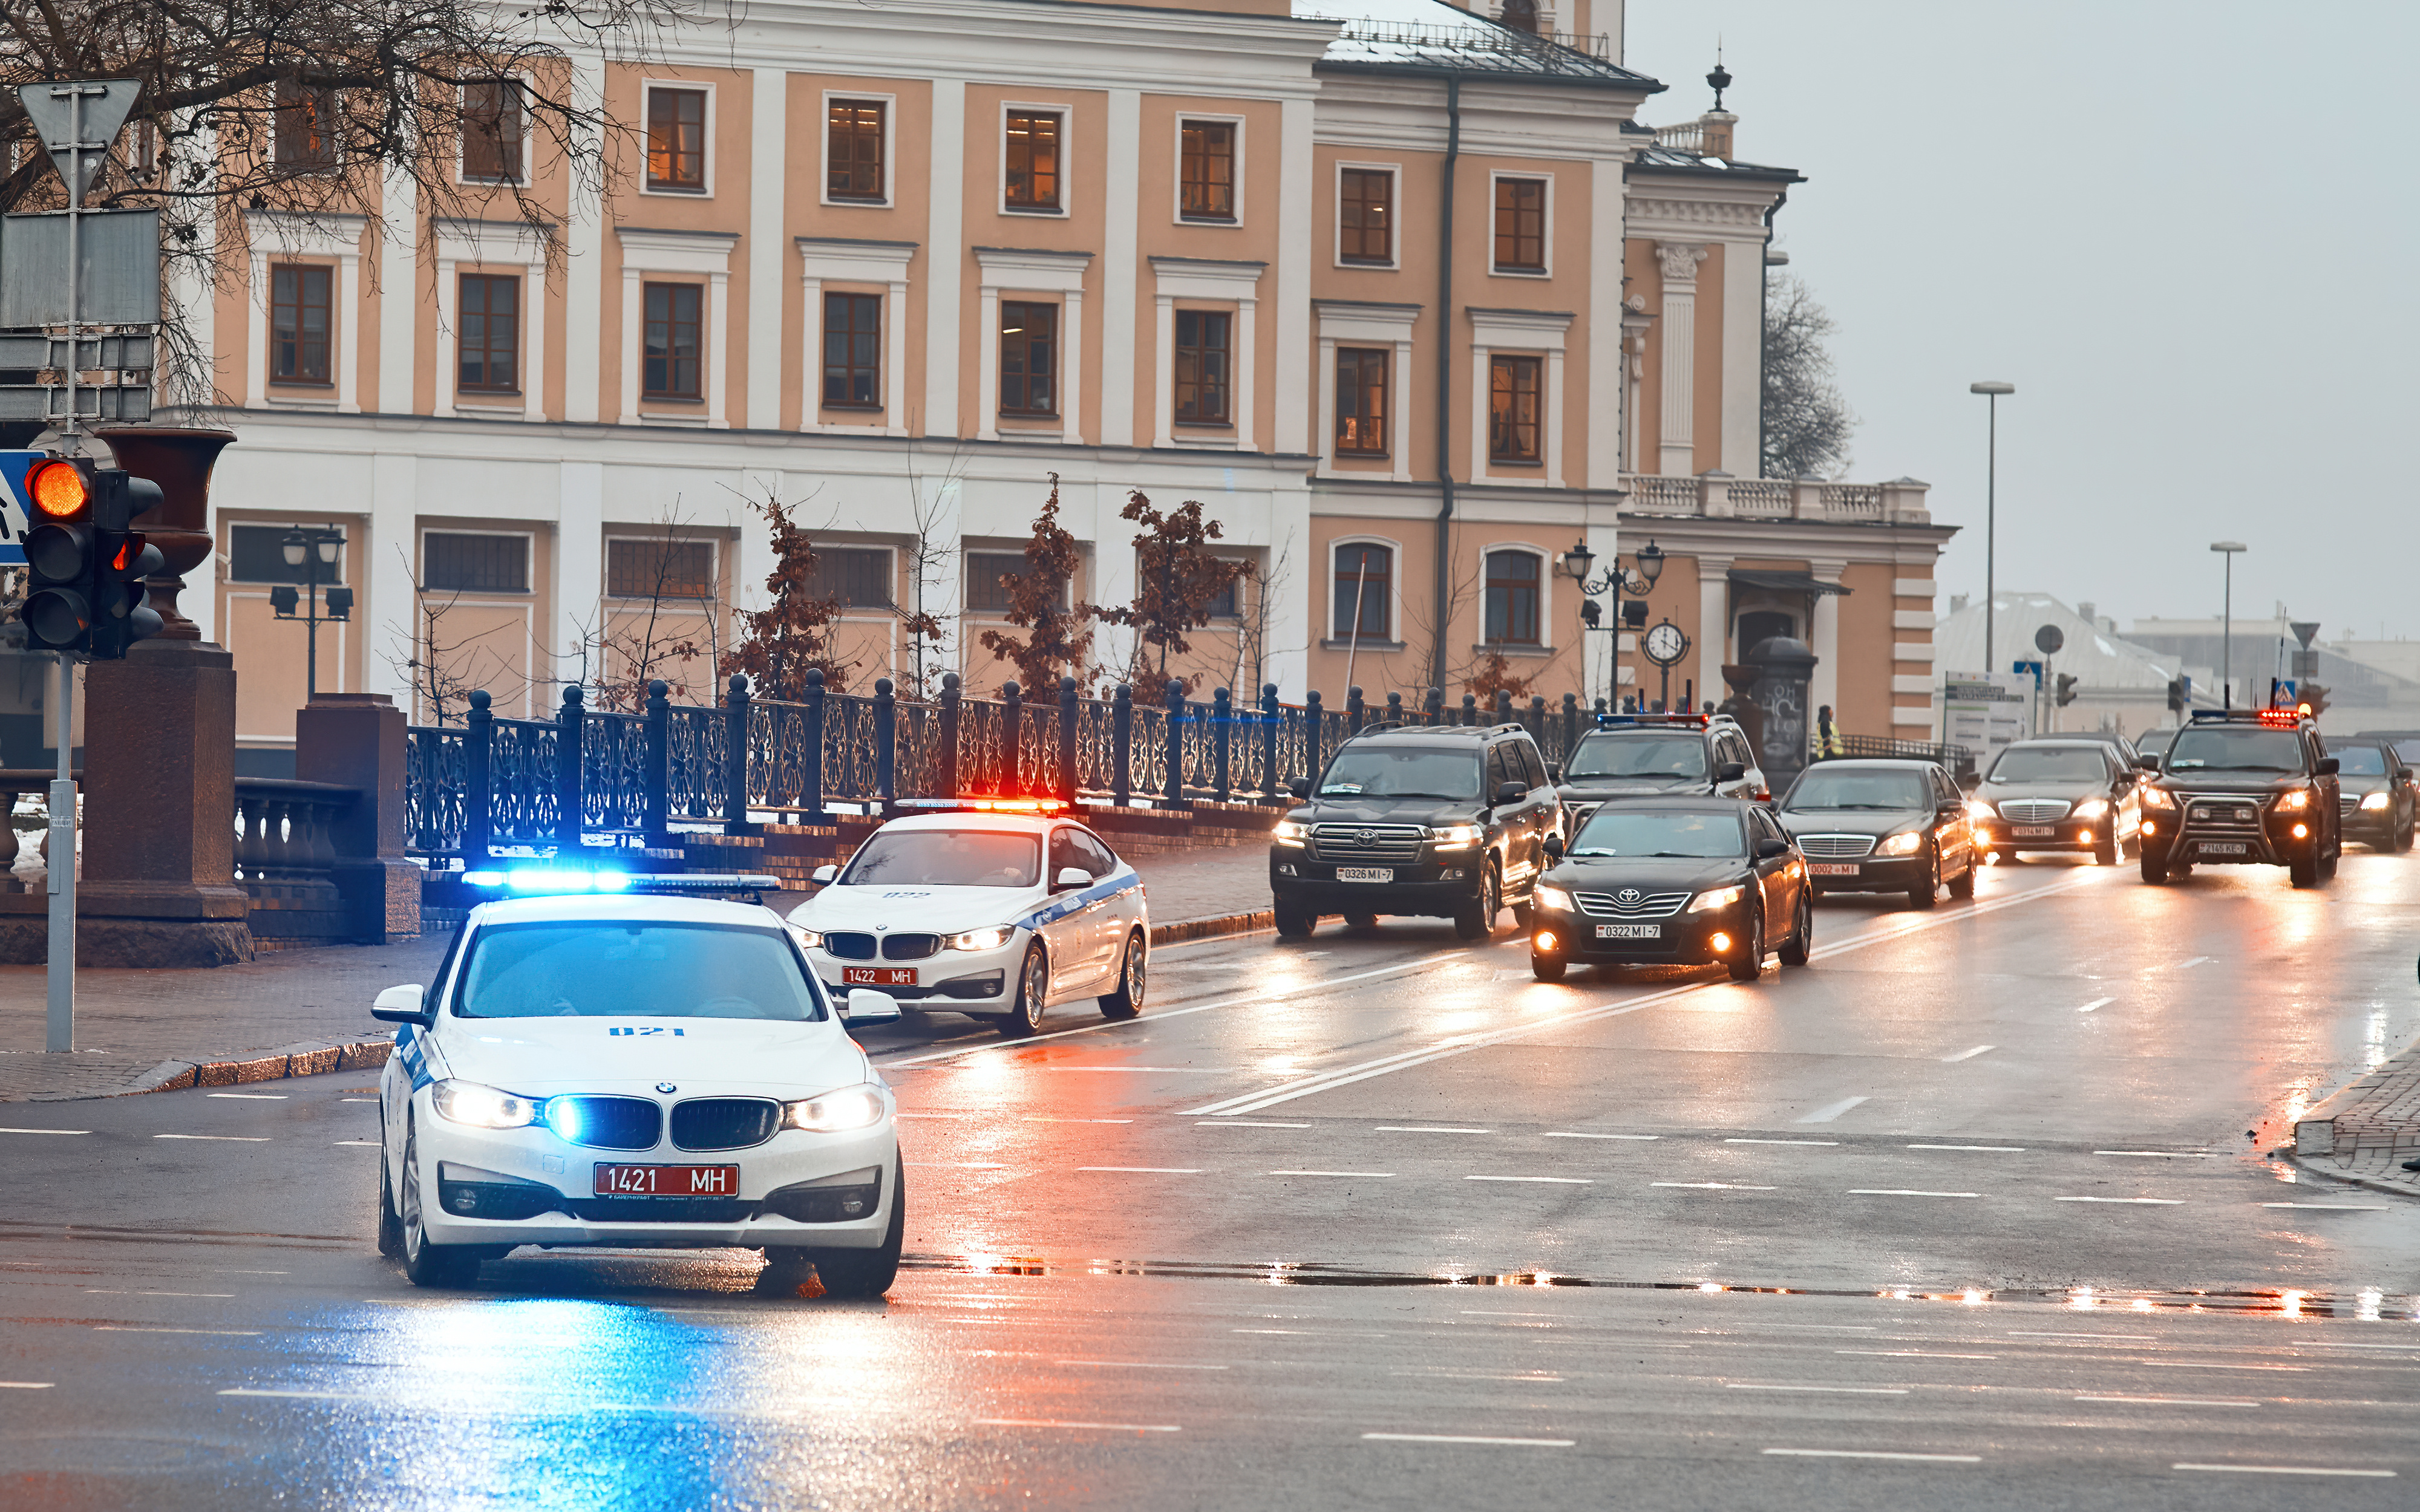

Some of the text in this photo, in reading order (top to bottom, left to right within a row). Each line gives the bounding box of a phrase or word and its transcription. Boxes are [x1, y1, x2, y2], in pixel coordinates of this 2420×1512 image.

[1345, 868, 1367, 879] 0326
[1811, 864, 1833, 874] 0002
[1606, 926, 1630, 937] 0322
[849, 969, 911, 983] 1422 MH
[609, 1027, 685, 1037] 021
[608, 1168, 725, 1192] 1421 MH
